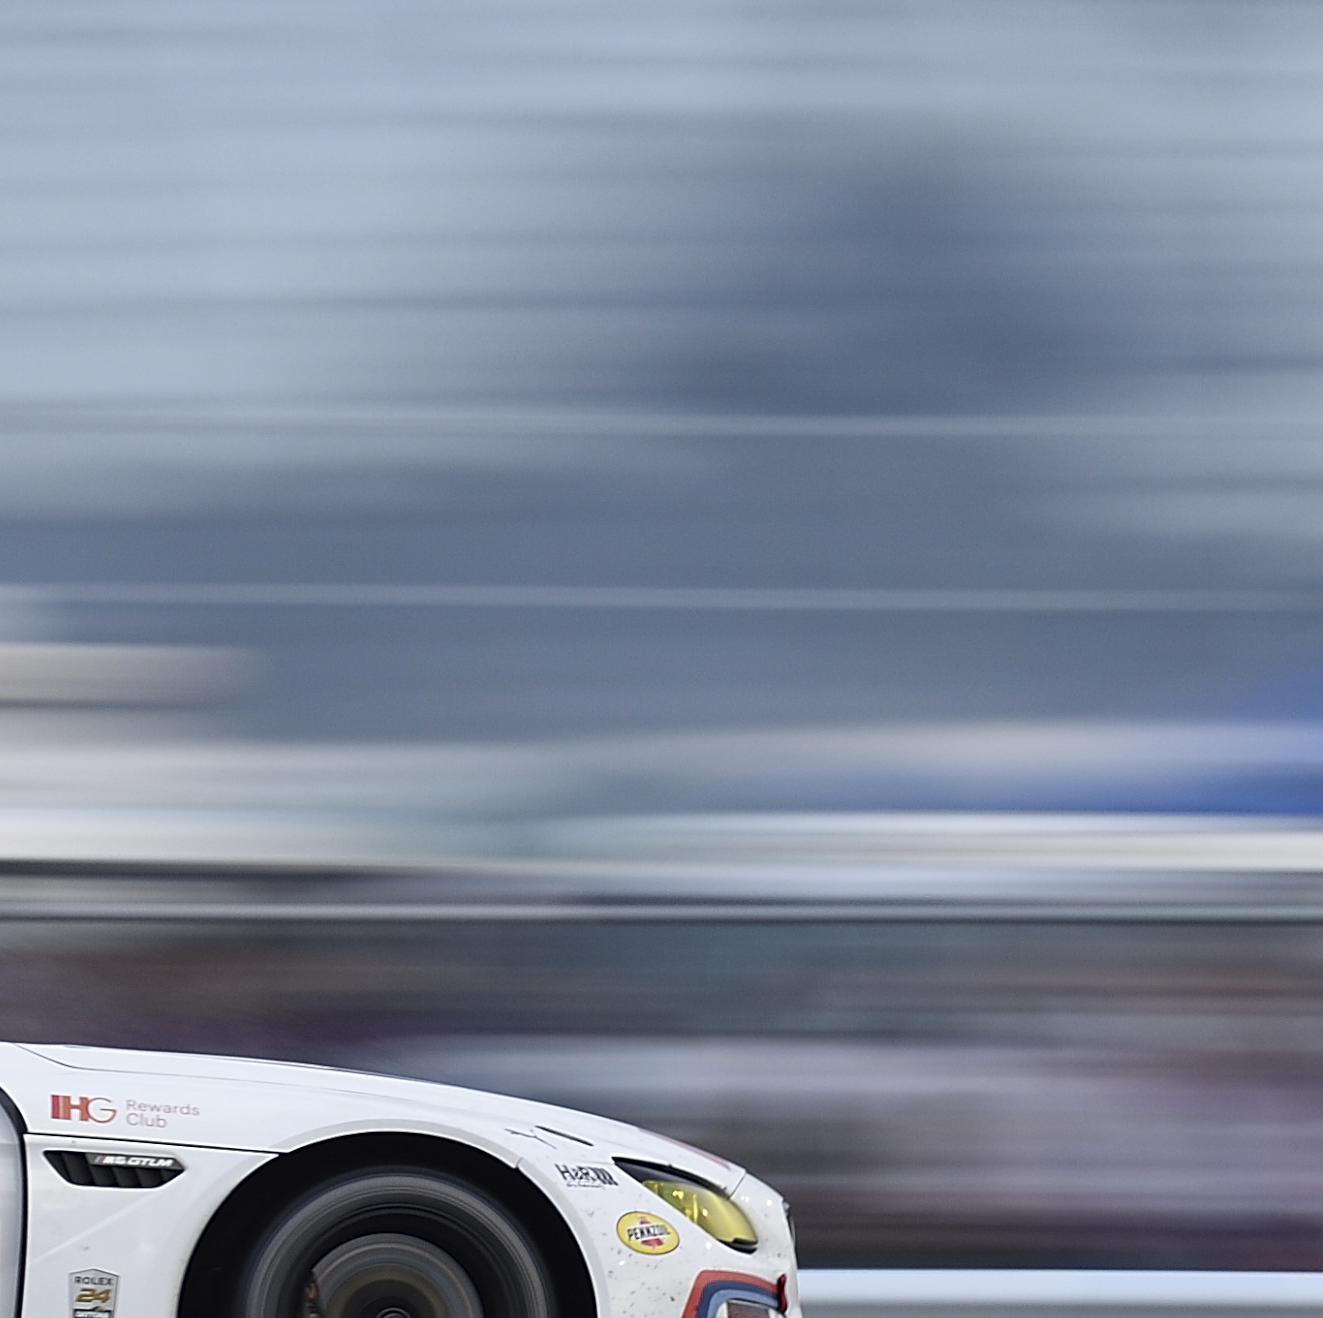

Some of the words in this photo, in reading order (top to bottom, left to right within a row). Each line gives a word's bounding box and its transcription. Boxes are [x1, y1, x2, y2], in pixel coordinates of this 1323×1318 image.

[50, 1094, 117, 1124] IHG
[125, 1099, 201, 1116] Rewards
[125, 1112, 168, 1128] Club
[74, 1276, 113, 1286] ROLEX
[75, 1288, 112, 1303] 24
